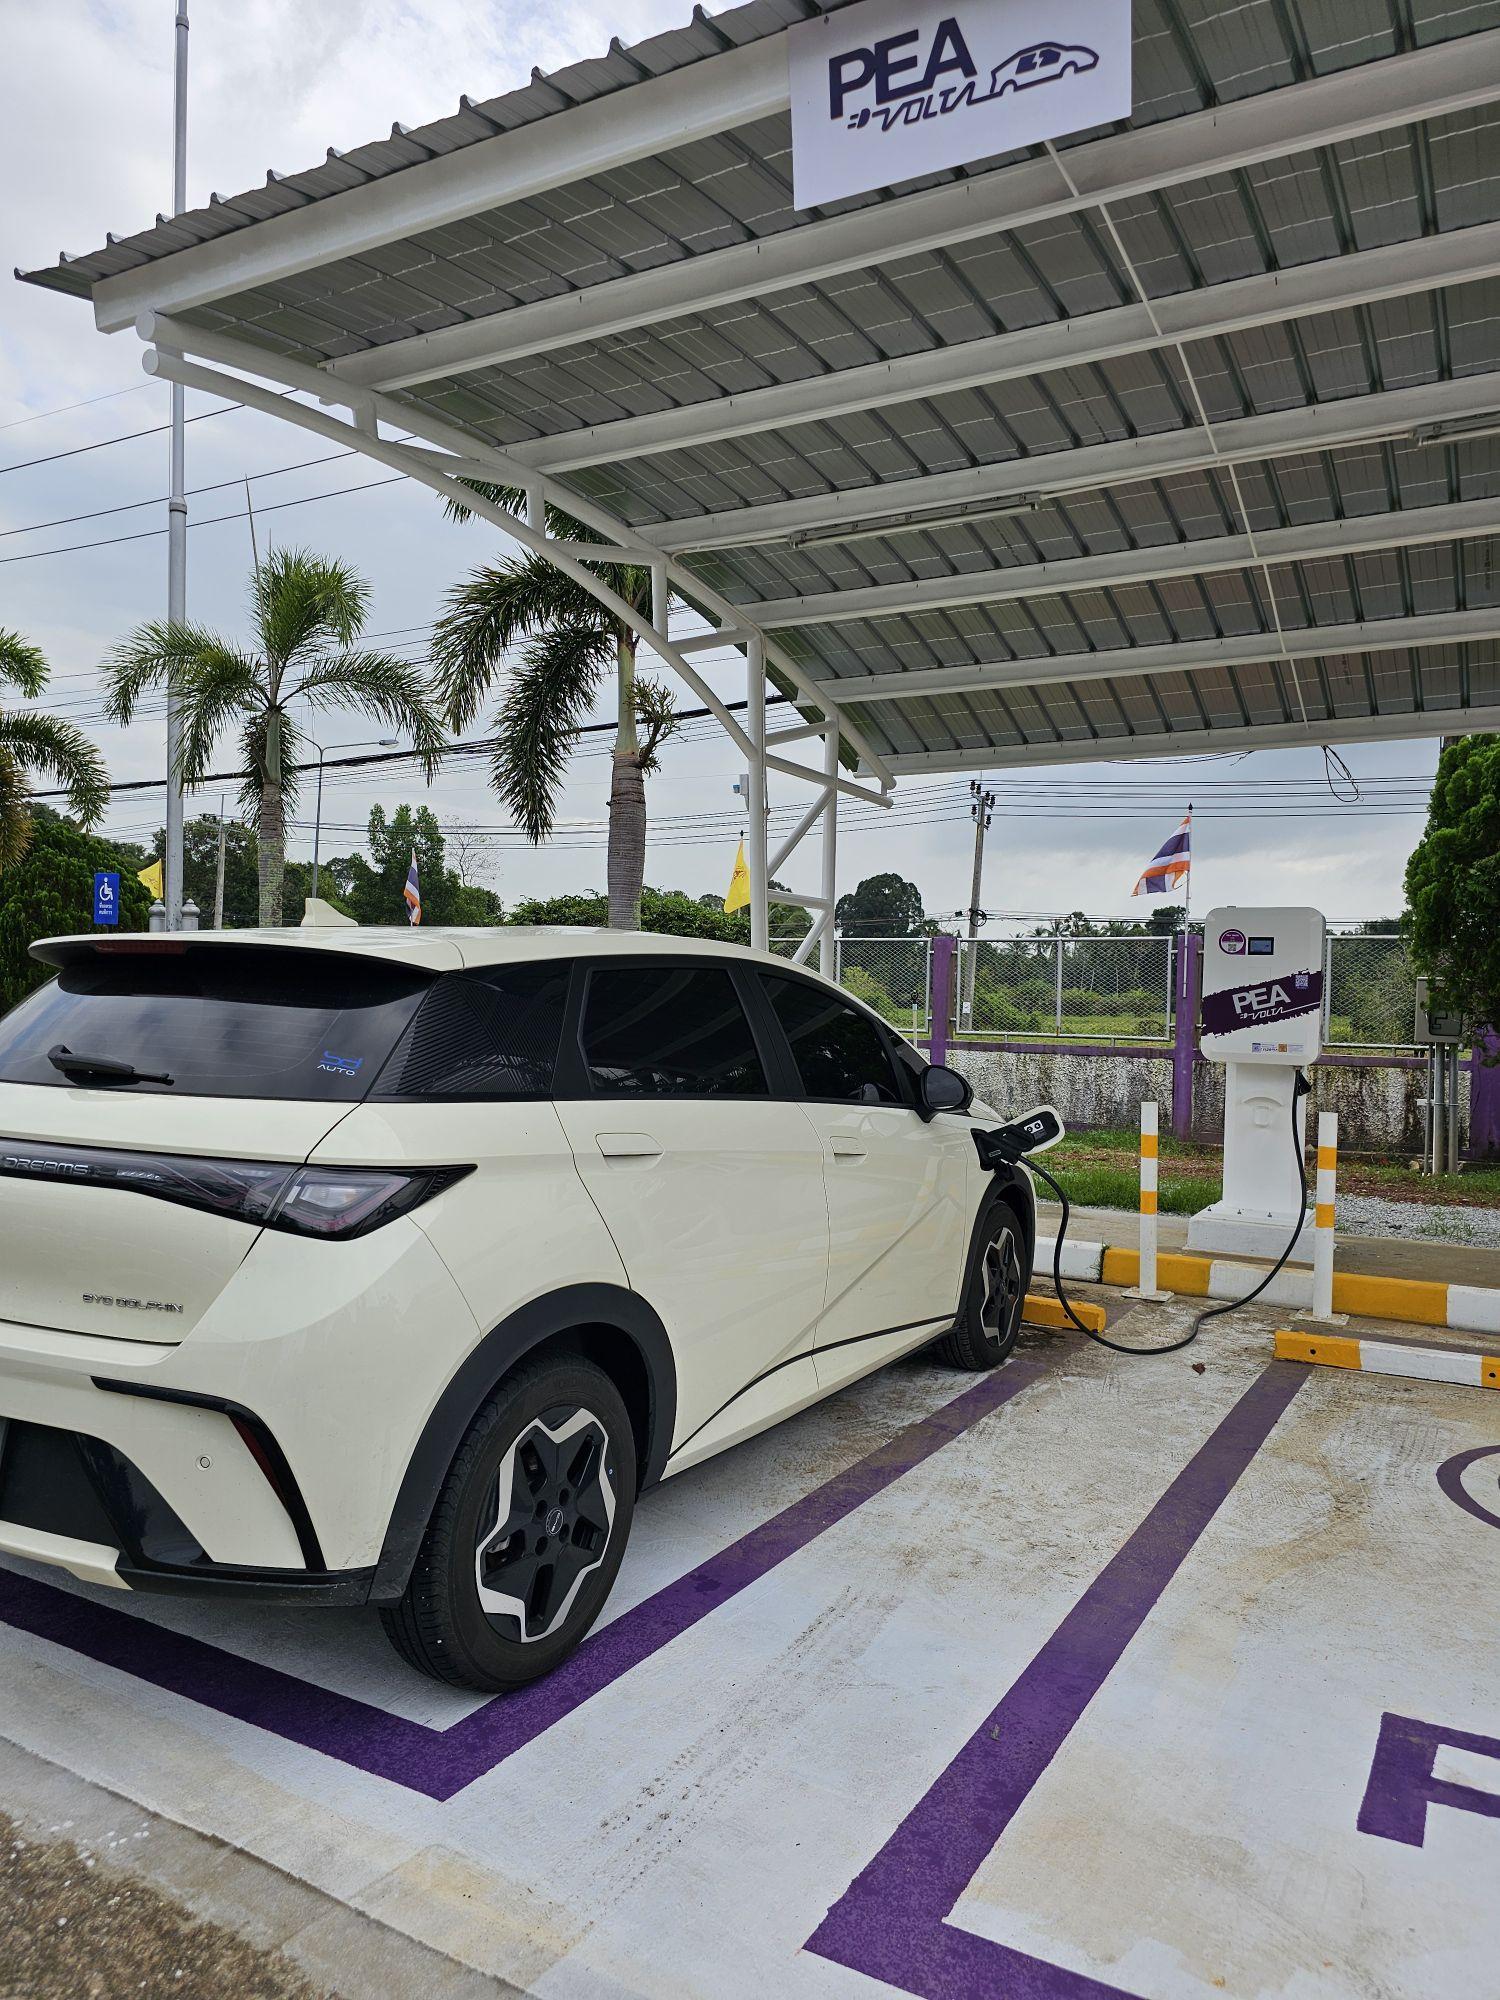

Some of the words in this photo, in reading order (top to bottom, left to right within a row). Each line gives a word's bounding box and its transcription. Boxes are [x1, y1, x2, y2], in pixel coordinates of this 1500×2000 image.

[828, 17, 977, 120] PEA
[871, 80, 976, 132] VOLTA
[1232, 984, 1292, 1014] PEA
[1249, 1006, 1284, 1020] VOLTA
[316, 1064, 356, 1076] AUTO
[3, 1157, 89, 1176] DREAMS
[82, 1293, 113, 1306] BYD
[116, 1296, 184, 1314] DOLPHIN
